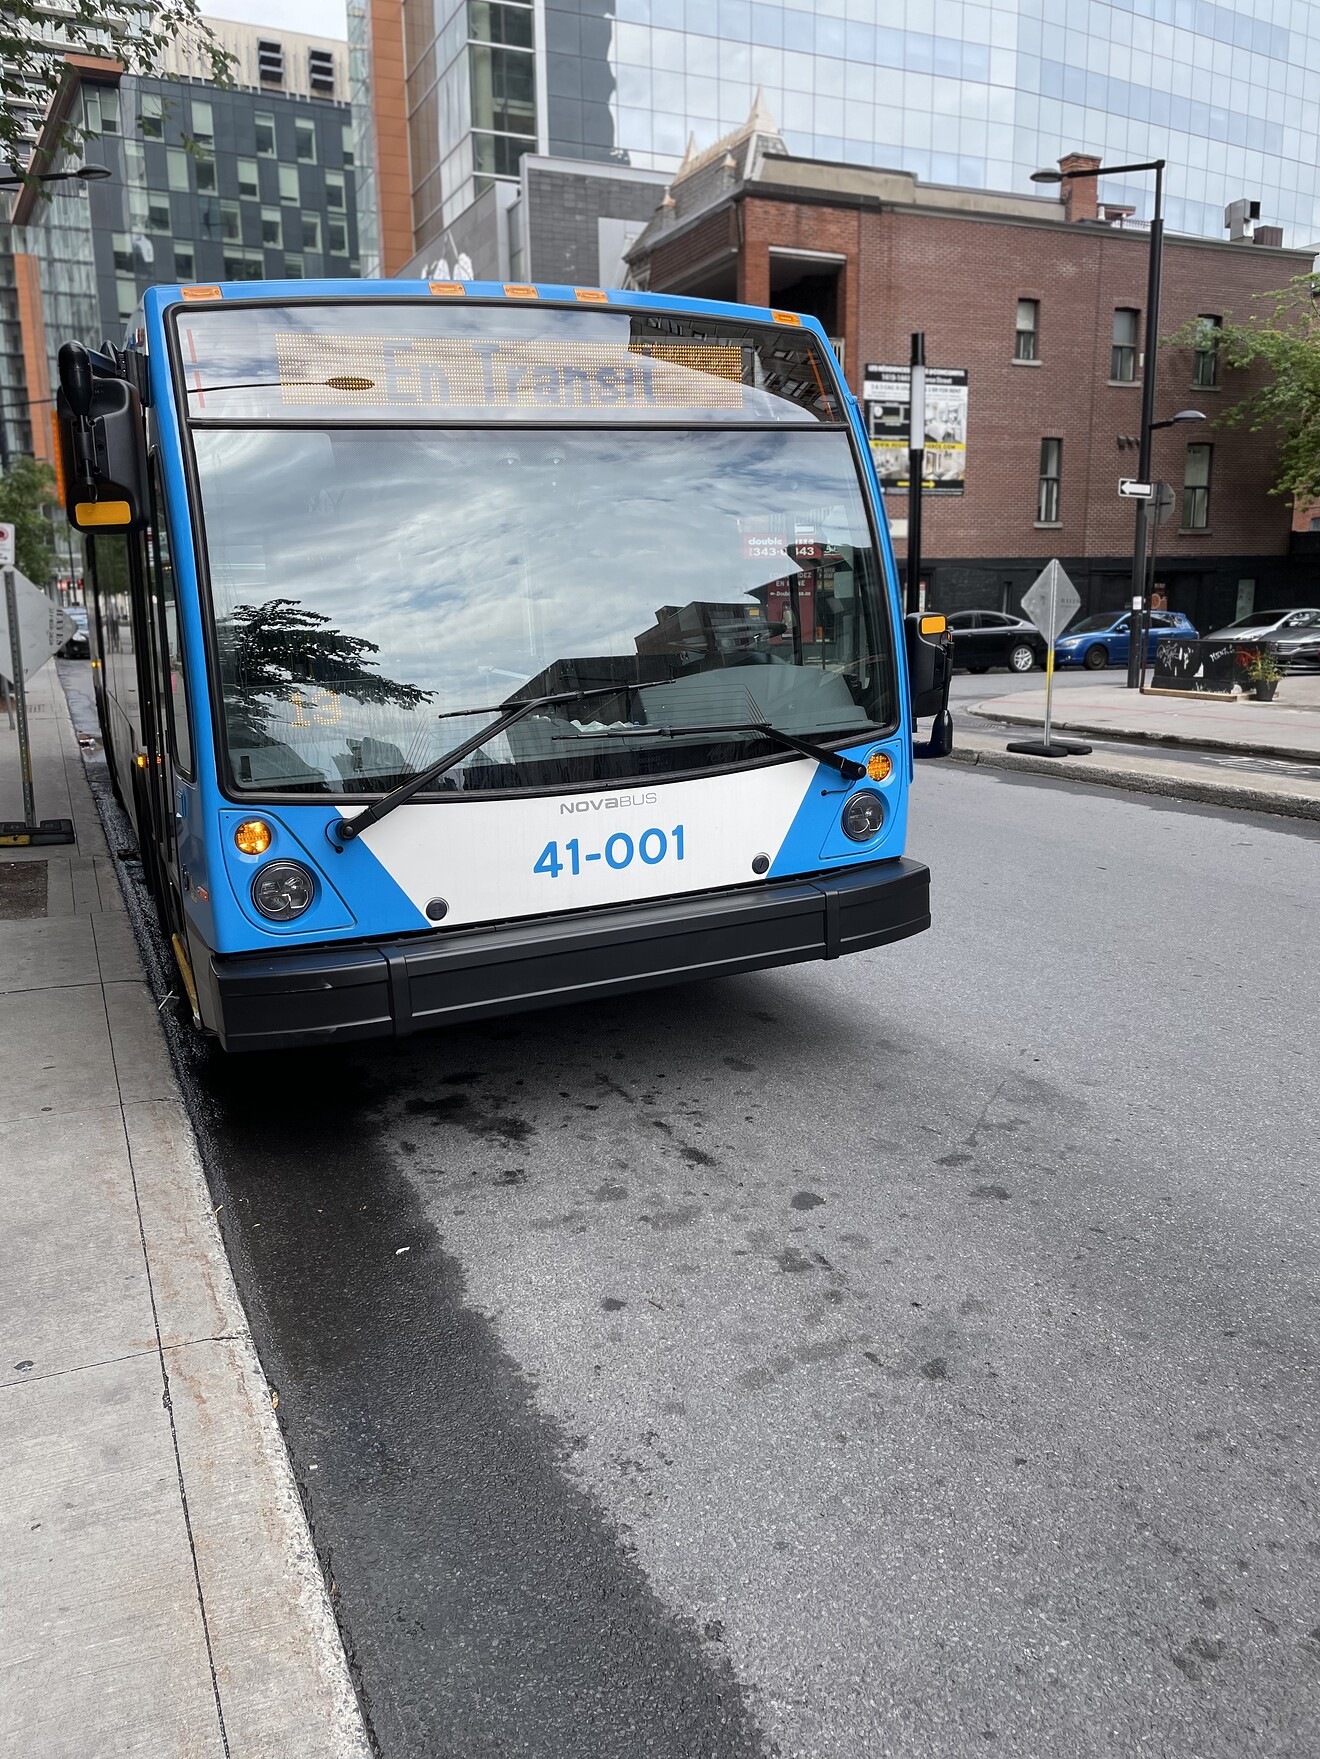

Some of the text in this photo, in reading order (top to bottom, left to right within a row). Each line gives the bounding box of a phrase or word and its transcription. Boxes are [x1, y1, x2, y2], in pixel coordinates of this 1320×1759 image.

[383, 340, 658, 406] En Transit
[748, 537, 783, 545] double
[288, 690, 342, 728] 13
[533, 824, 684, 878] 41-001
